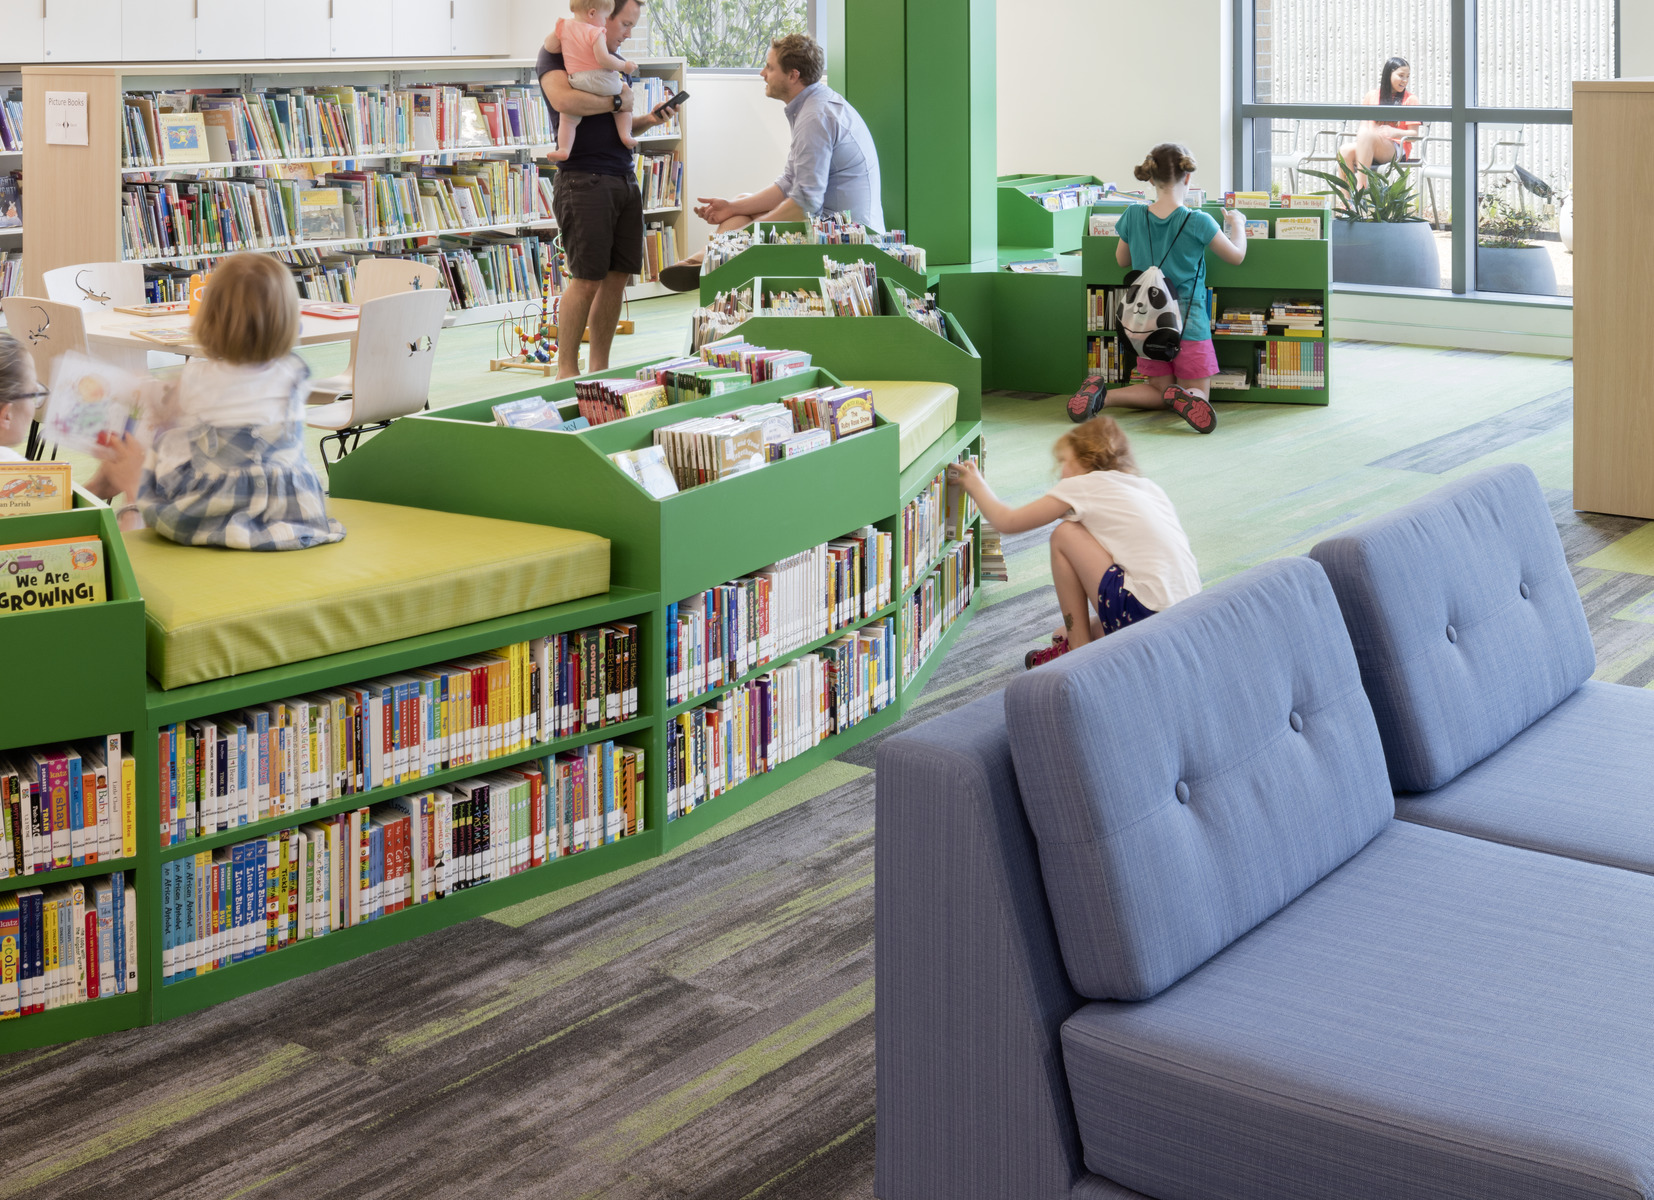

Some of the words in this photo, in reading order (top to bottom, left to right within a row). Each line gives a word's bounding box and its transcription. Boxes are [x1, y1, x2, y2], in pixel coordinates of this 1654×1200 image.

[48, 98, 66, 106] Picture
[68, 98, 84, 106] Books
[16, 574, 38, 588] We
[44, 572, 70, 584] Are
[0, 582, 94, 611] GROWING!
[260, 758, 268, 784] WAKE
[54, 797, 66, 830] shap
[98, 790, 108, 815] Baby
[575, 792, 583, 820] shap
[235, 870, 243, 895] Little
[235, 896, 243, 914] Blue
[0, 919, 18, 928] katz
[5, 948, 15, 983] color
